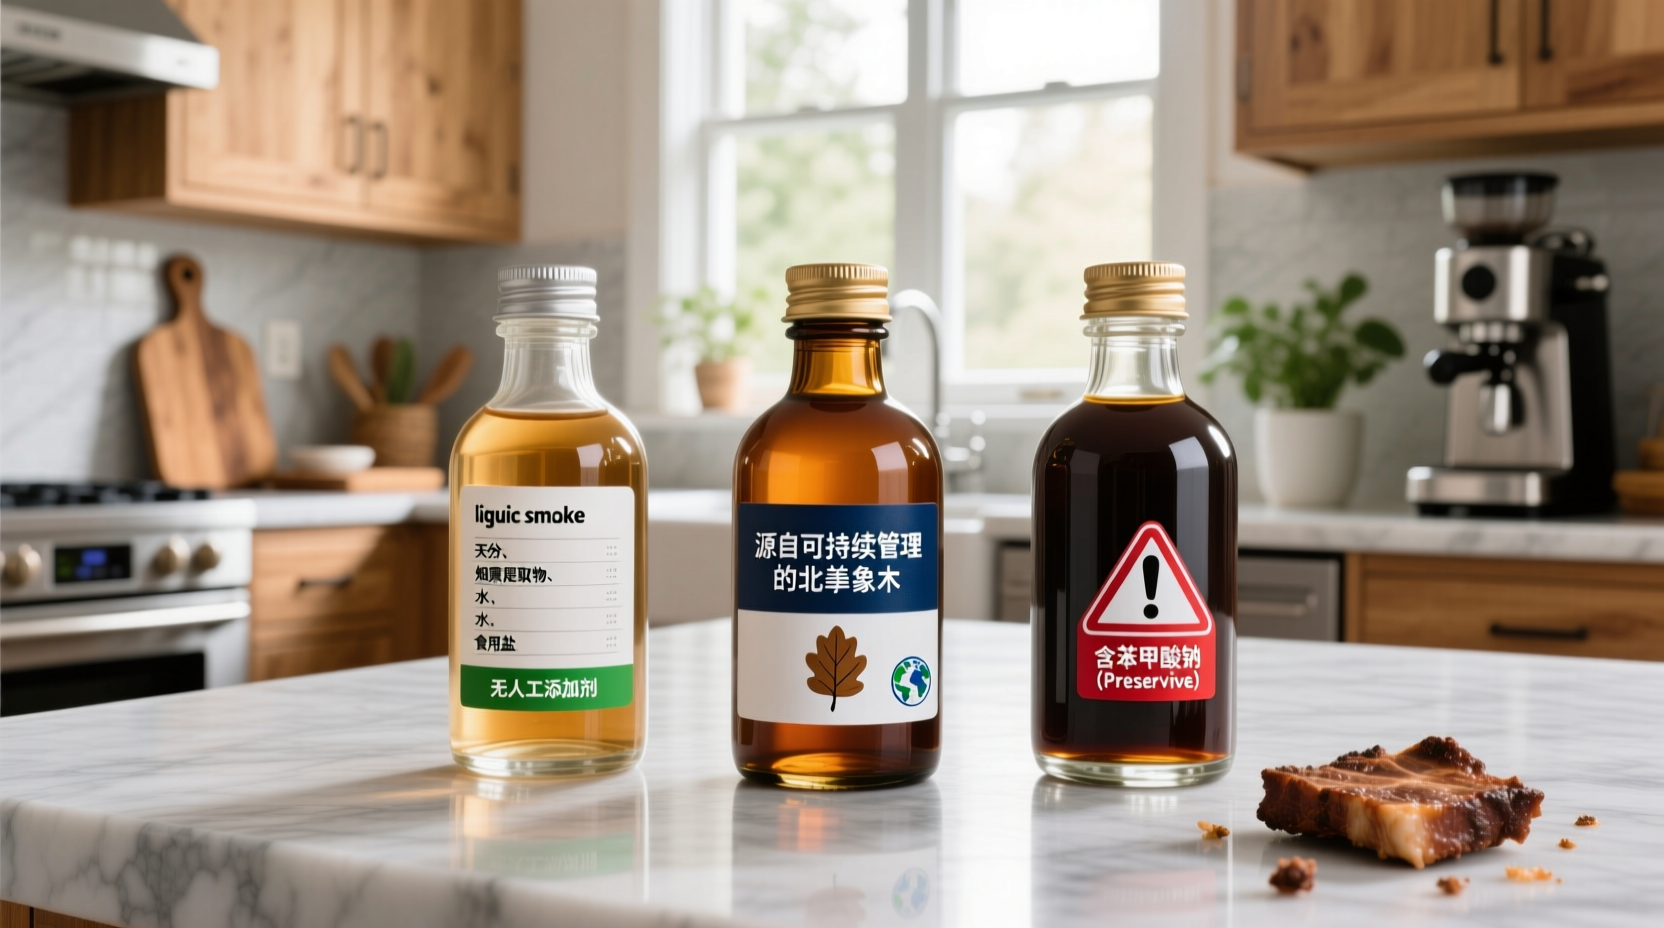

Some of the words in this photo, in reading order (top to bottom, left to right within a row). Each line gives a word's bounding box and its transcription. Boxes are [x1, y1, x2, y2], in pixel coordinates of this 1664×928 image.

[524, 506, 586, 524] smoke
[754, 531, 923, 560] 源自可持续管理
[490, 677, 598, 699] 无人工添加剂
[1096, 670, 1200, 691] (Preservive)
